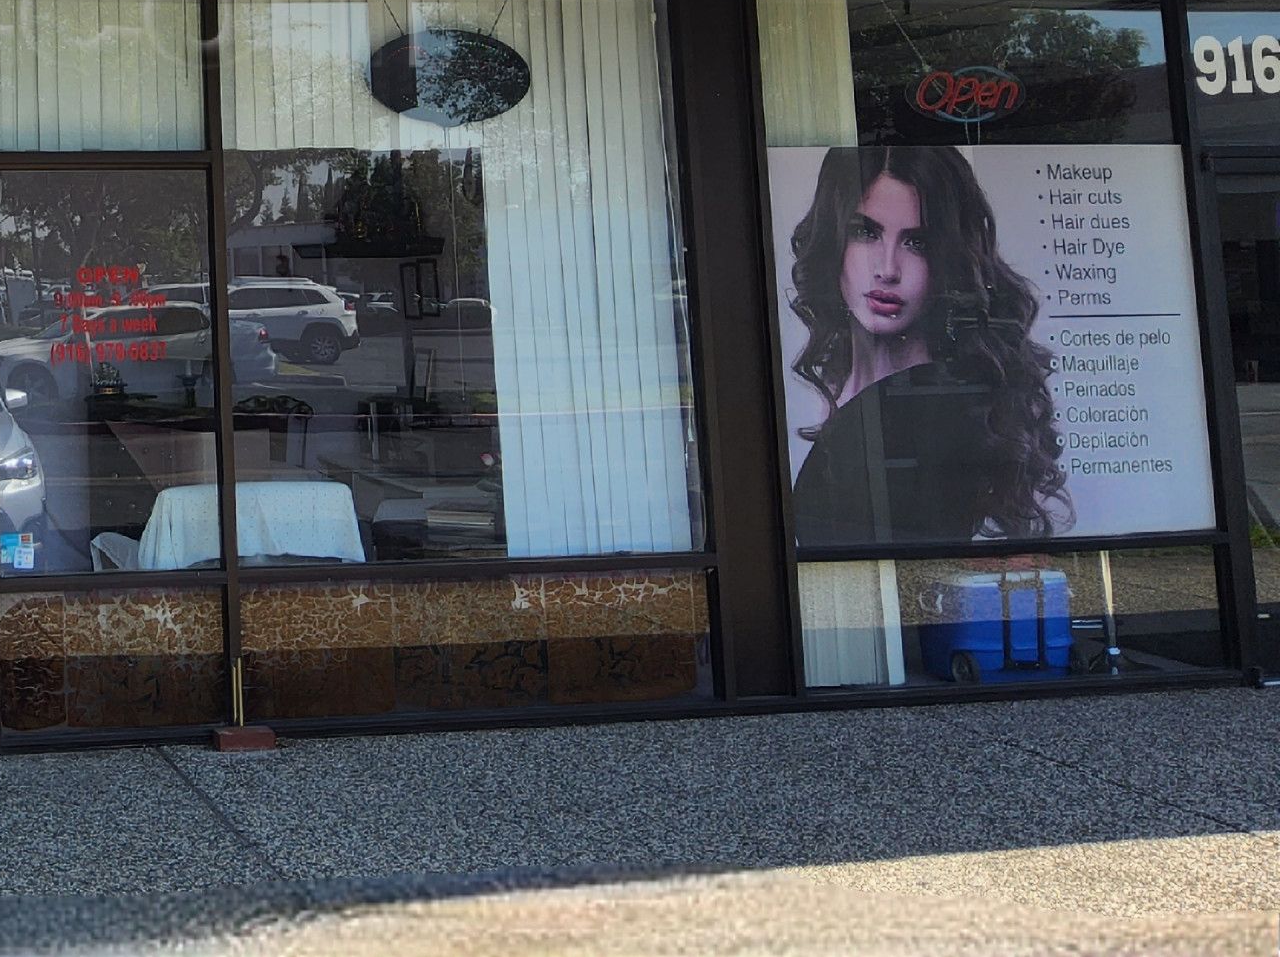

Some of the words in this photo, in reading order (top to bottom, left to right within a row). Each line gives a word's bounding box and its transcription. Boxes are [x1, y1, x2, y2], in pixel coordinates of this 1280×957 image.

[1193, 34, 1280, 95] 916
[1047, 163, 1113, 184] Makeup
[1049, 189, 1082, 205] Hair
[1088, 190, 1123, 205] cuts
[1052, 214, 1085, 230] Hair
[1090, 214, 1131, 230] dues
[1054, 238, 1088, 255] Hair
[1092, 238, 1125, 259] Dye
[76, 265, 138, 284] OPEN
[1056, 263, 1117, 284] Waxing
[1058, 289, 1111, 306] Perms
[123, 315, 158, 333] week
[1060, 329, 1111, 346] Cortes
[1115, 330, 1134, 346] de
[1139, 328, 1171, 349] pelo
[1062, 354, 1139, 375] Maquillaje
[1064, 380, 1136, 397] Peinados
[1066, 405, 1148, 423] Coloración
[1069, 431, 1149, 452] Depilación
[1071, 457, 1173, 475] Permanentes
